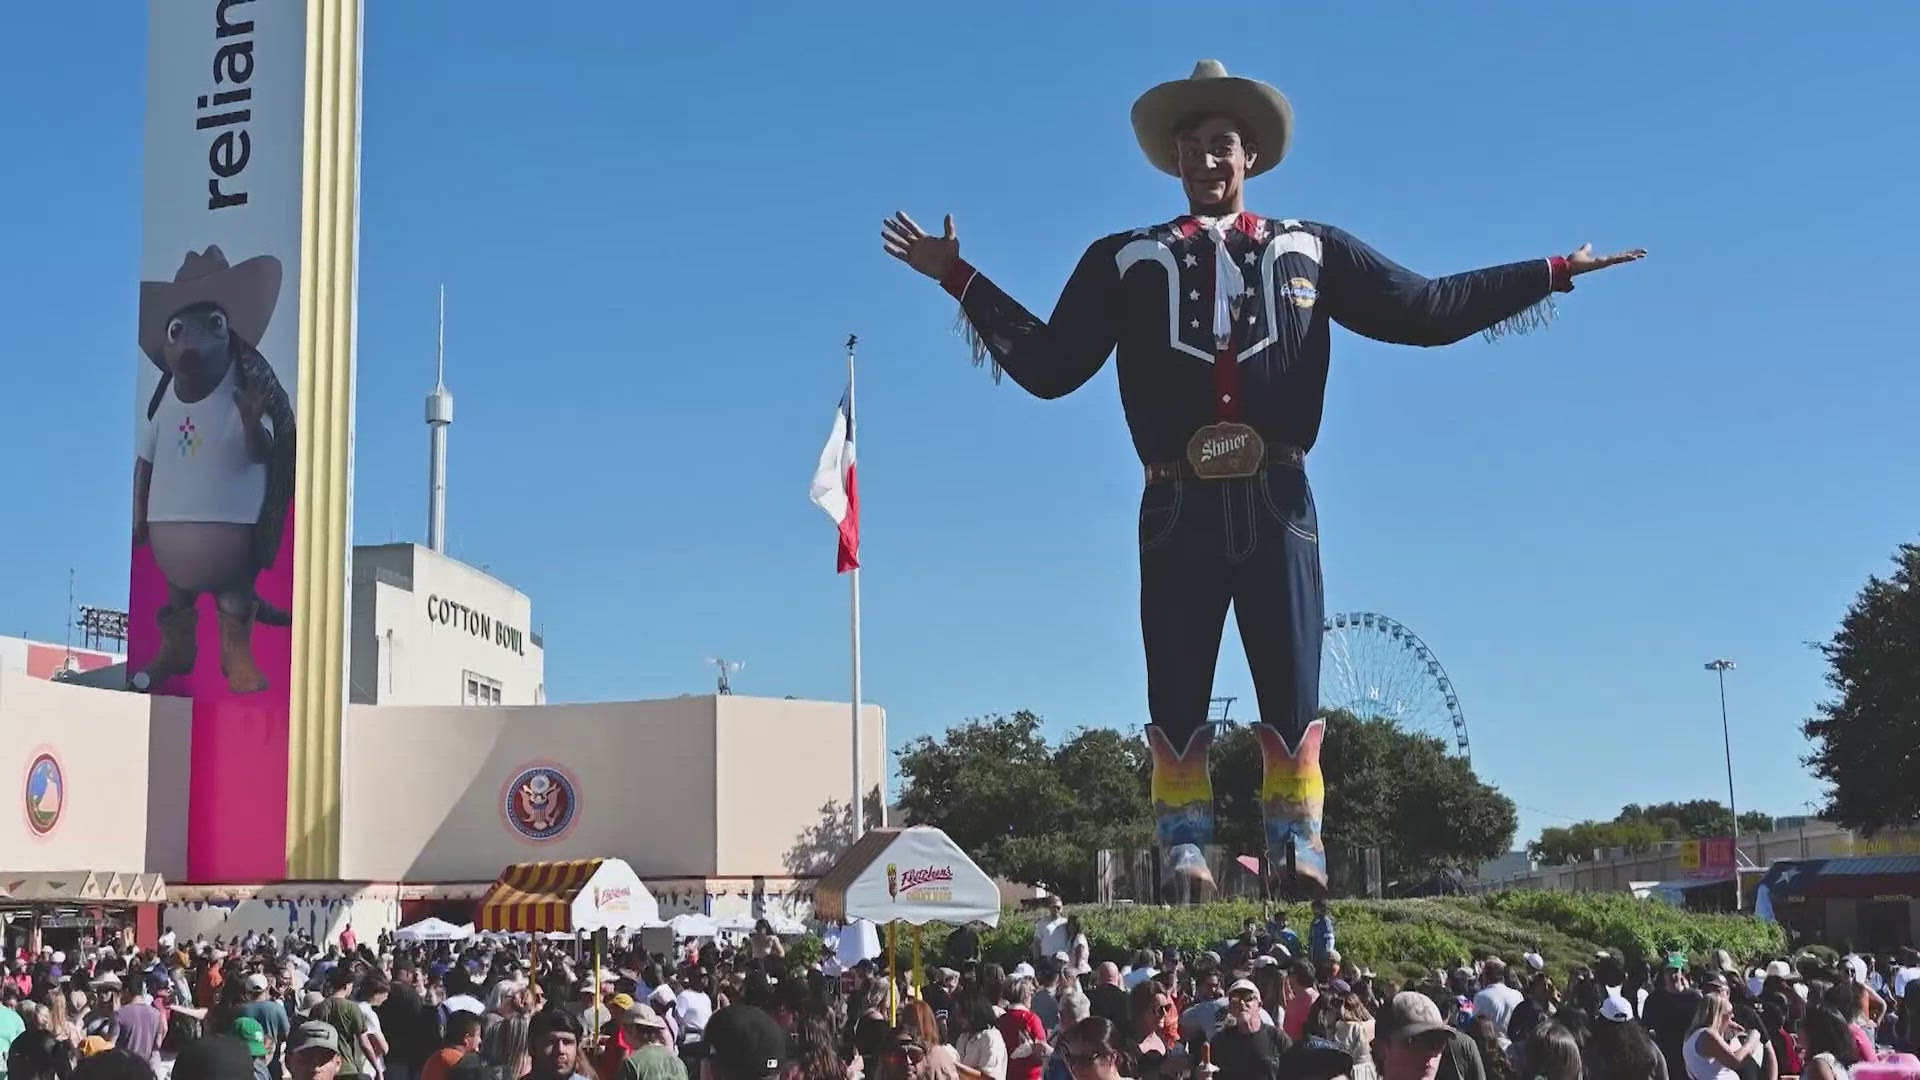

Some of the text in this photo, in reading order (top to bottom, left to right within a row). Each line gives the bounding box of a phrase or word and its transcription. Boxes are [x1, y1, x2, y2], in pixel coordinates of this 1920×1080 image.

[196, 0, 255, 210] relian
[1201, 433, 1249, 463] Shiner
[427, 593, 525, 656] COTTON BOWL
